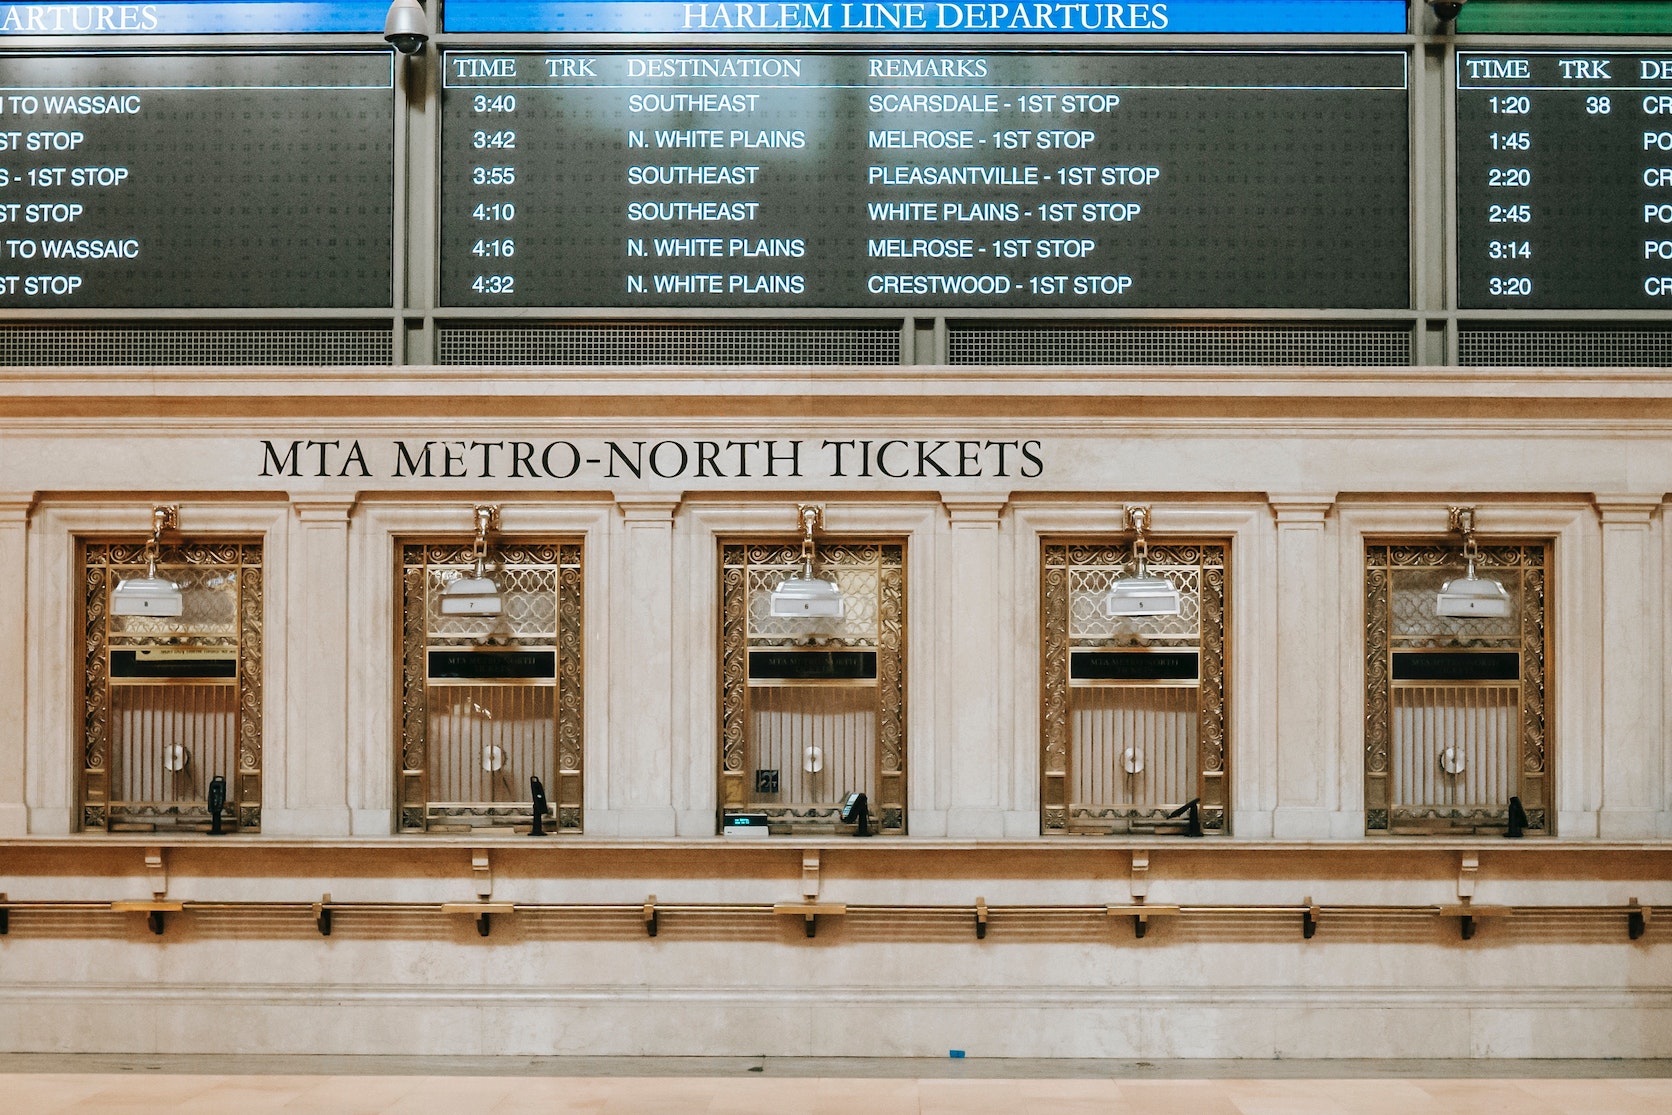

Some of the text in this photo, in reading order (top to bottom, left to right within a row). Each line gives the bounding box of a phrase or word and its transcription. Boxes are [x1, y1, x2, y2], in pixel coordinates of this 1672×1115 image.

[0, 5, 158, 31] ARTURES
[682, 3, 1169, 29] HARLEM LINE DEPARTURES
[453, 59, 988, 78] TIME TRK DESTINATION REMARKS
[1466, 60, 1672, 80] TIME TRK DE
[8, 96, 38, 115] TO
[44, 96, 141, 115] WASSAIC
[474, 95, 516, 113] 3:40
[628, 95, 760, 113] SOUTHEAST
[868, 95, 998, 113] SCARSDALE
[1018, 95, 1056, 113] 1ST
[1062, 95, 1120, 113] STOP
[1489, 96, 1531, 115] 1:20
[1586, 96, 1611, 115] 38
[26, 132, 84, 151] STOP
[473, 131, 516, 149] 3:42
[628, 131, 649, 149] N.
[655, 131, 724, 149] WHITE
[730, 131, 806, 149] PLAINS
[868, 131, 974, 149] MELROSE
[993, 131, 1032, 149] 1ST
[1037, 131, 1095, 149] STOP
[1489, 132, 1531, 151] 1:45
[28, 168, 67, 187] 1ST
[70, 168, 129, 187] STOP
[473, 167, 515, 186] 3:55
[628, 167, 760, 186] SOUTHEAST
[868, 167, 1039, 186] PLEASANTVILLE
[1058, 167, 1097, 186] 1ST
[1102, 167, 1160, 186] STOP
[1488, 169, 1531, 188] 2:20
[25, 204, 83, 223] STOP
[472, 203, 515, 222] 4:10
[627, 203, 760, 222] SOUTHEAST
[868, 203, 938, 222] WHITE
[943, 203, 1020, 222] PLAINS
[1038, 203, 1077, 222] 1ST
[1082, 203, 1140, 222] STOP
[1488, 205, 1531, 223] 2:45
[6, 240, 36, 259] TO
[42, 240, 139, 259] WASSAIC
[472, 239, 515, 258] 4:16
[627, 239, 648, 258] N.
[654, 239, 724, 258] WHITE
[729, 239, 805, 258] PLAINS
[868, 239, 974, 258] MELROSE
[993, 239, 1032, 258] 1ST
[1037, 239, 1095, 258] STOP
[1488, 241, 1531, 260] 3:14
[24, 276, 82, 295] STOP
[472, 275, 515, 295] 4:32
[627, 275, 648, 295] N.
[654, 275, 724, 295] WHITE
[729, 275, 805, 295] PLAINS
[867, 275, 1011, 295] CRESTWOOD
[1030, 275, 1069, 295] 1ST
[1074, 275, 1132, 295] STOP
[1489, 277, 1532, 296] 3:20
[257, 440, 1044, 480] MTA METRO-NORTH TICKETS
